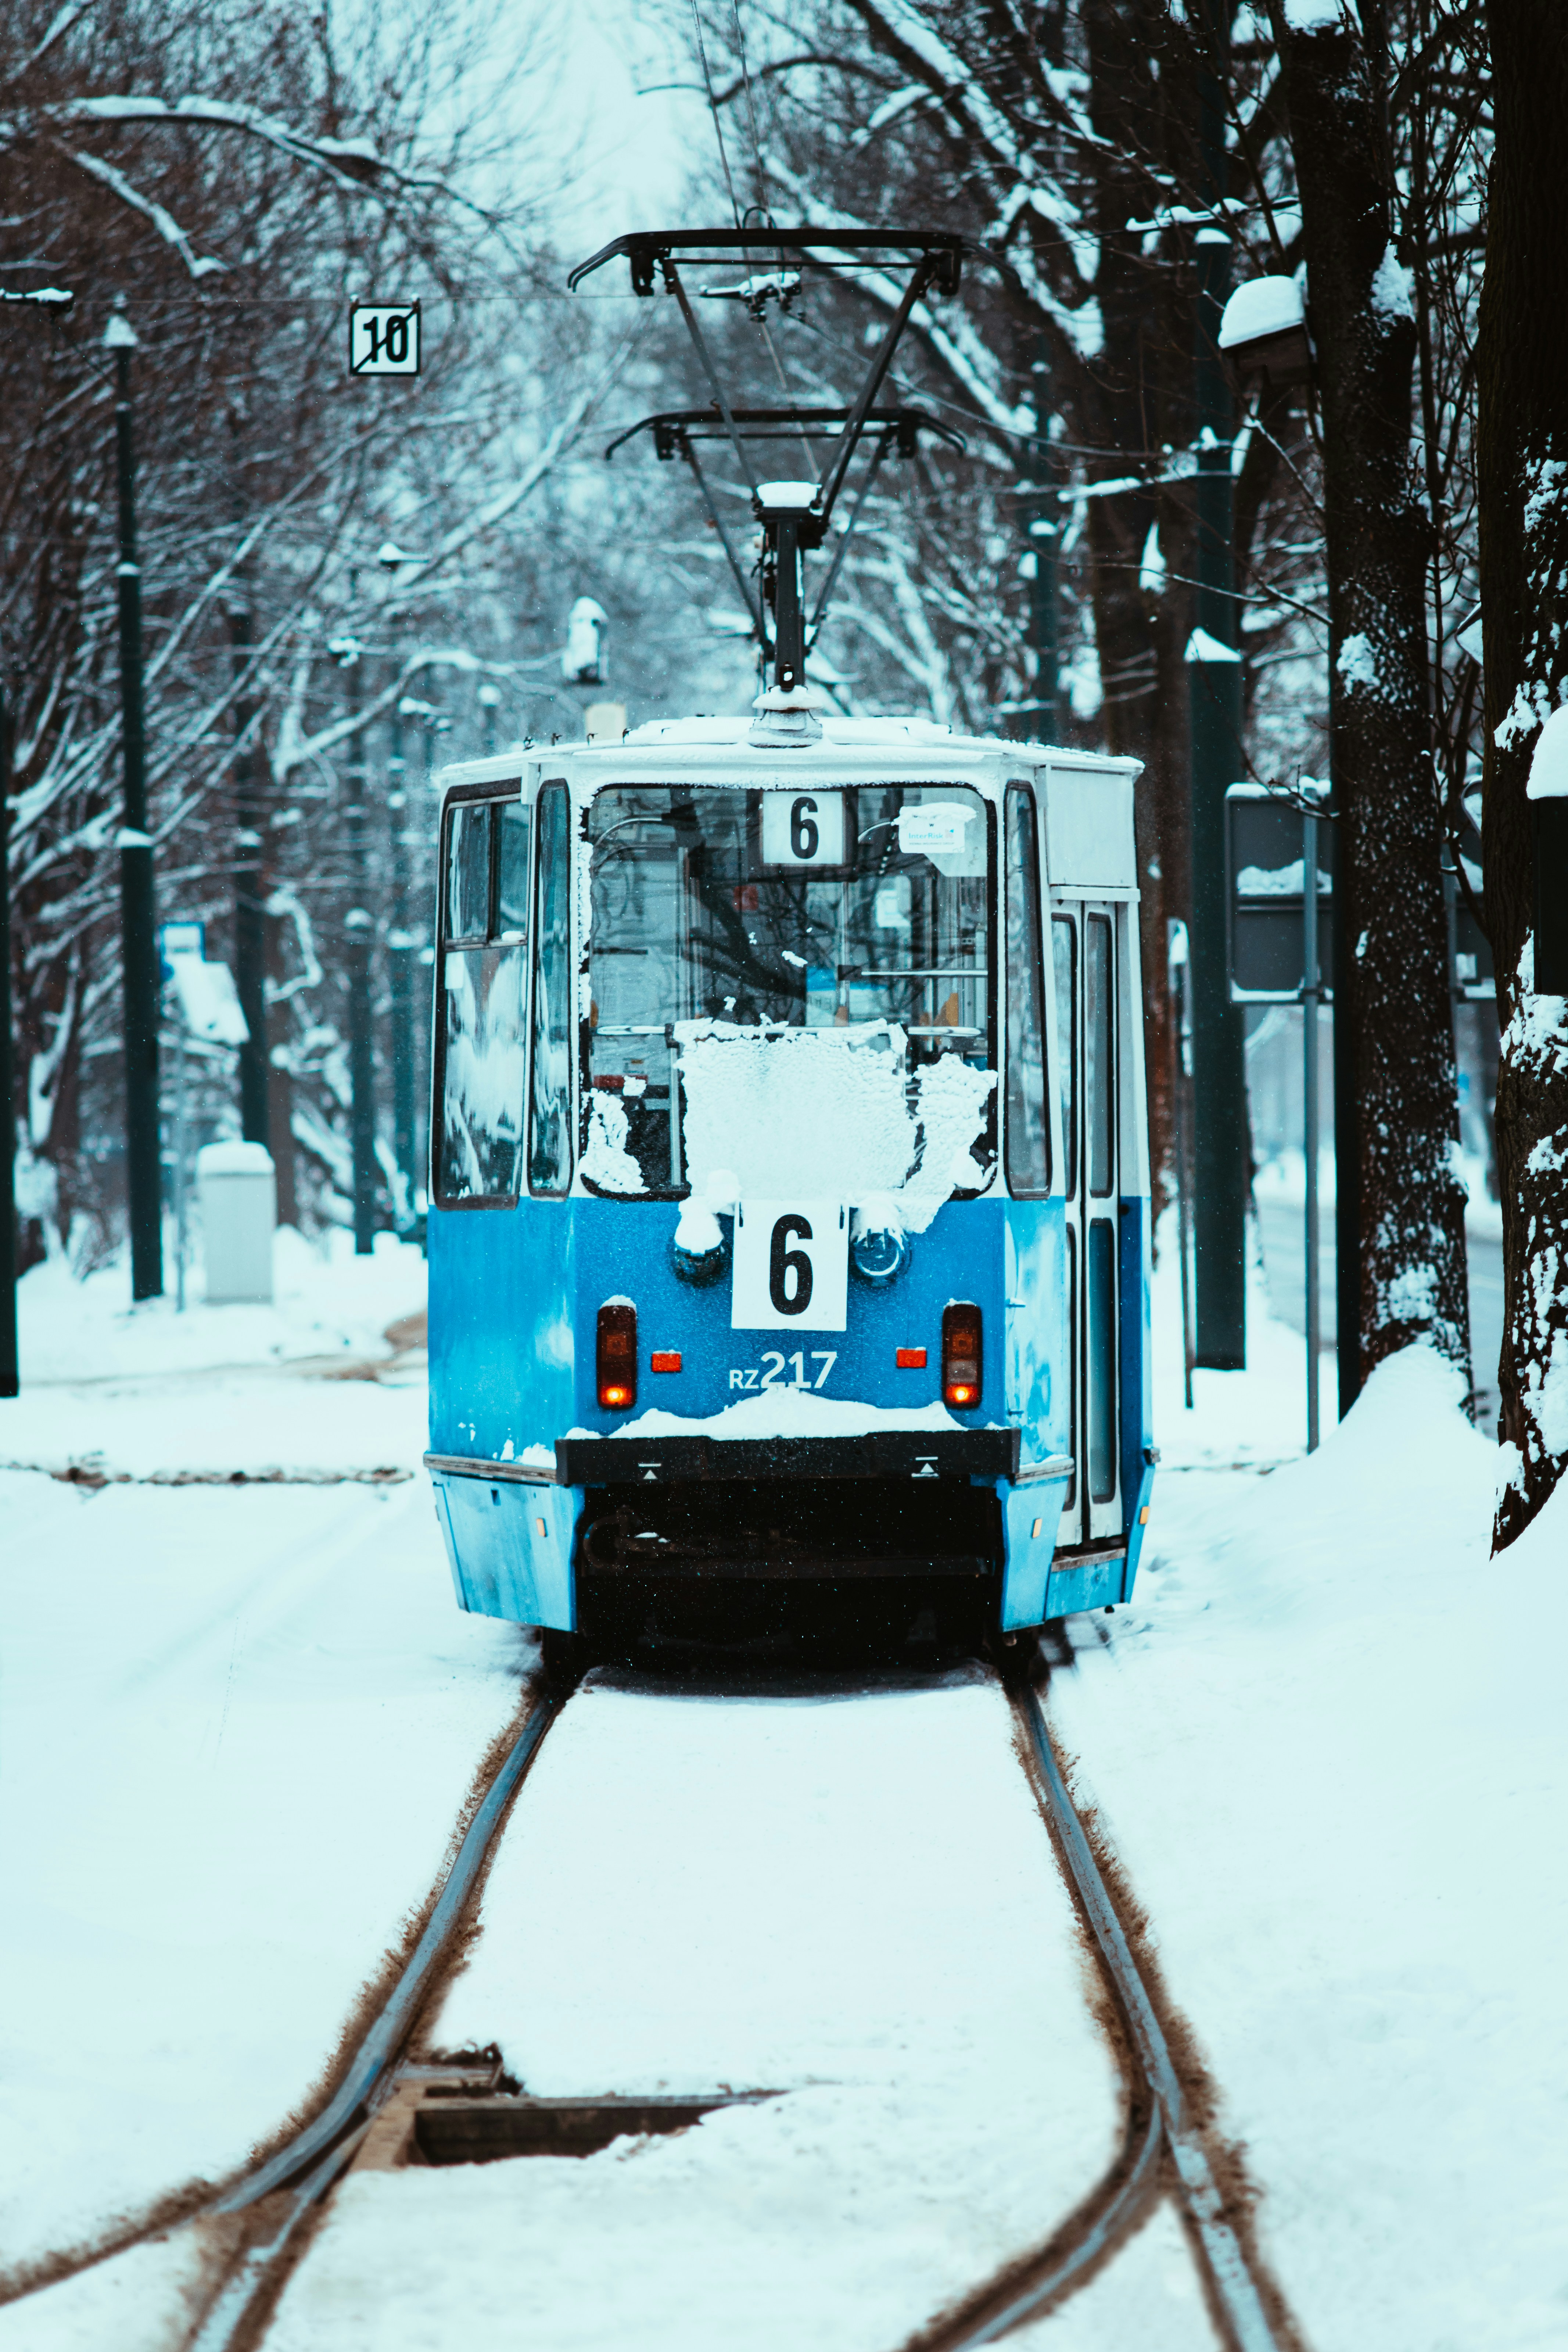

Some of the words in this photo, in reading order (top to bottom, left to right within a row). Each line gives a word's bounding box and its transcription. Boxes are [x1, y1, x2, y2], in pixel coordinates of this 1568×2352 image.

[363, 315, 408, 363] 10
[791, 796, 819, 859] 6
[769, 1214, 813, 1315] 6
